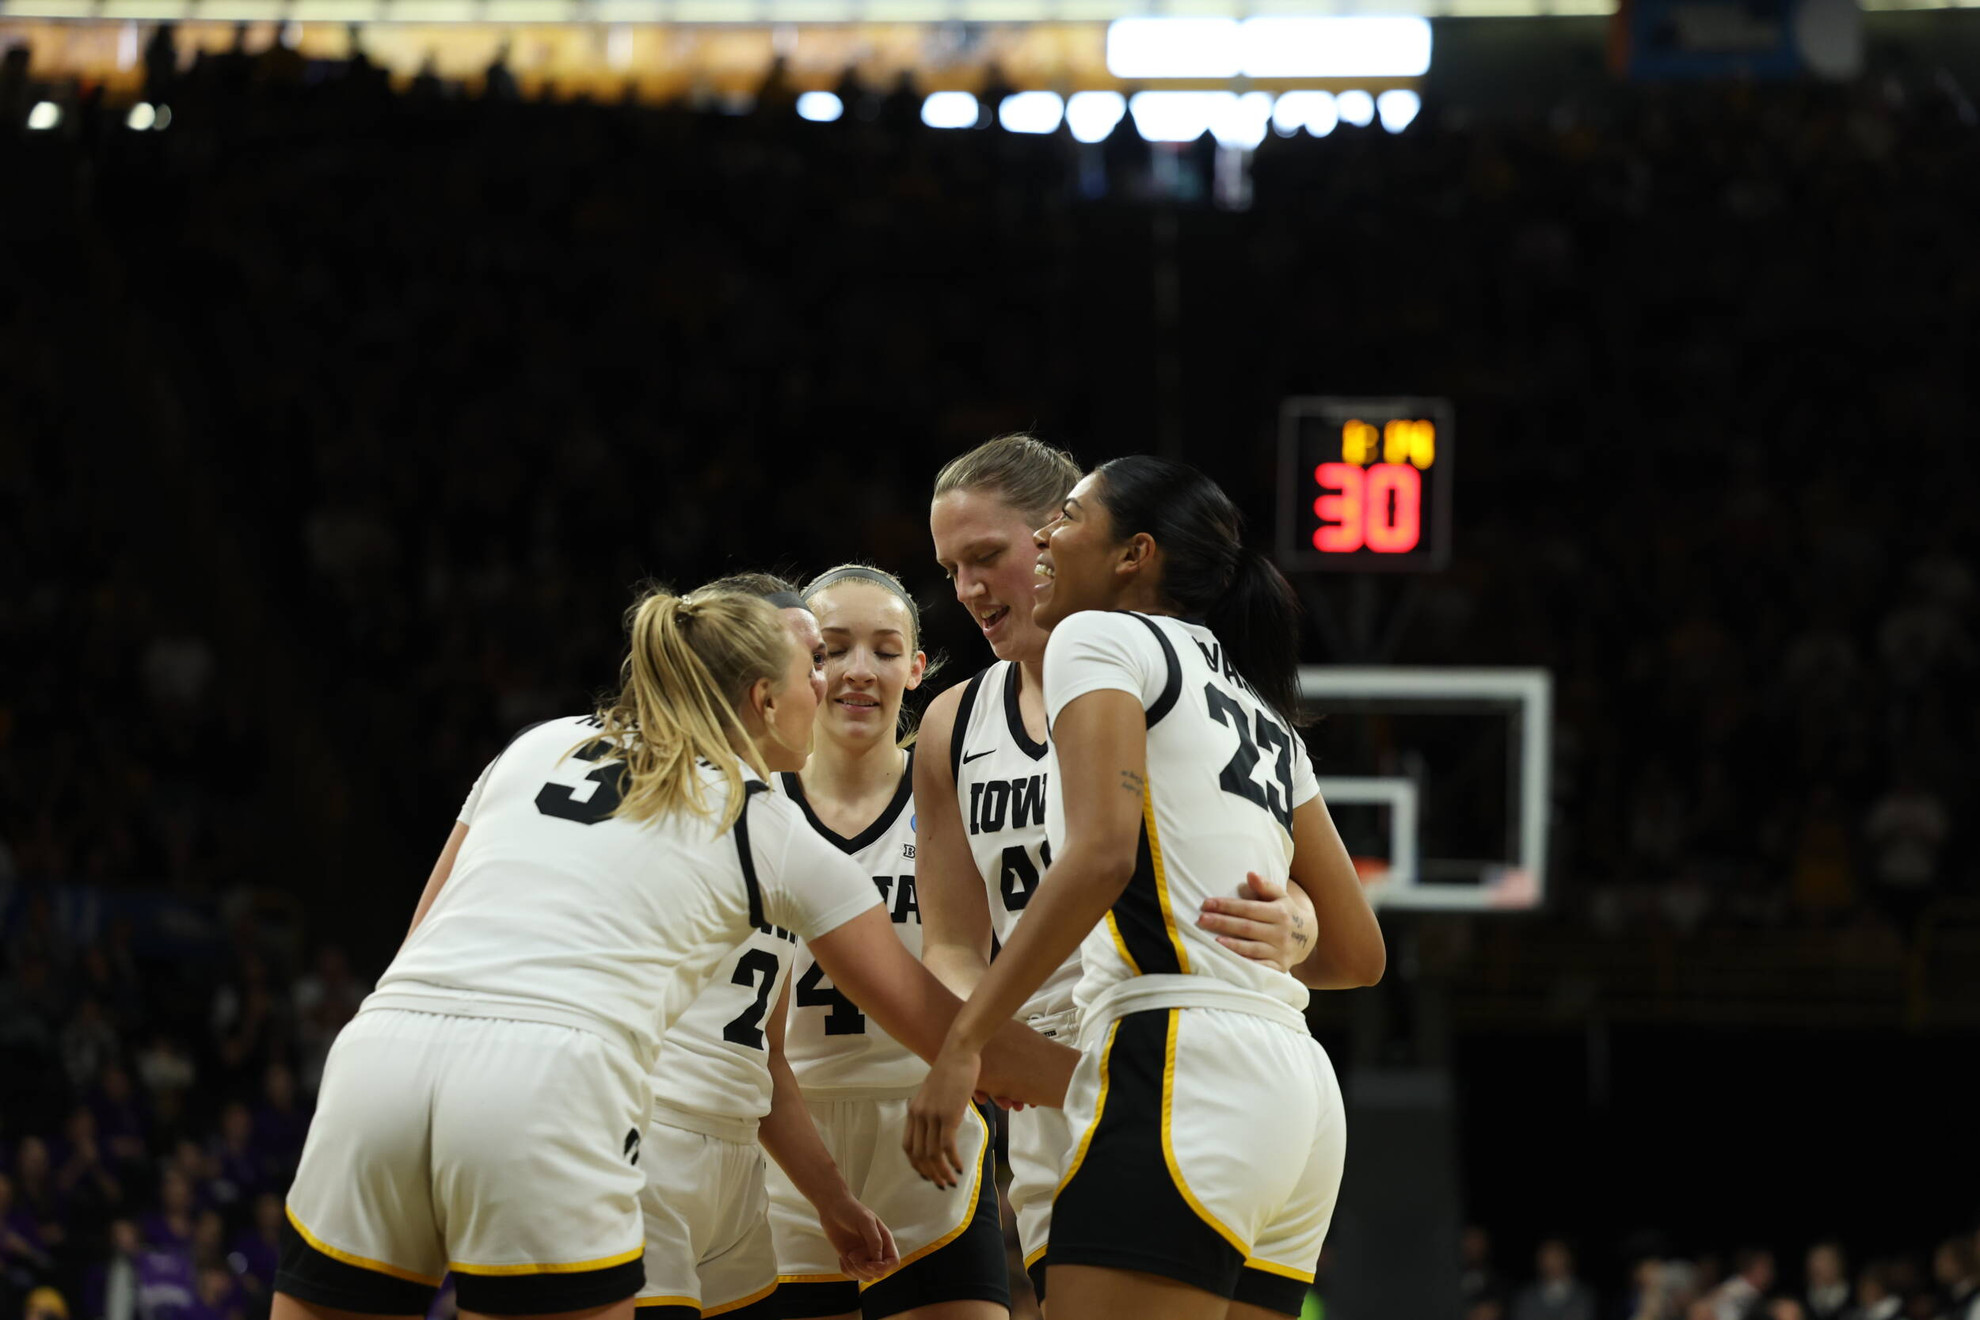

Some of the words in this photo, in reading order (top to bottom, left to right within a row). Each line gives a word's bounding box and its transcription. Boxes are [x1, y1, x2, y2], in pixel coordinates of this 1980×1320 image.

[1312, 462, 1422, 554] 30
[534, 738, 634, 826] 3
[1204, 681, 1294, 841] 23
[1000, 844, 1053, 912] 4
[723, 948, 780, 1051] 2
[796, 960, 866, 1036] 4
